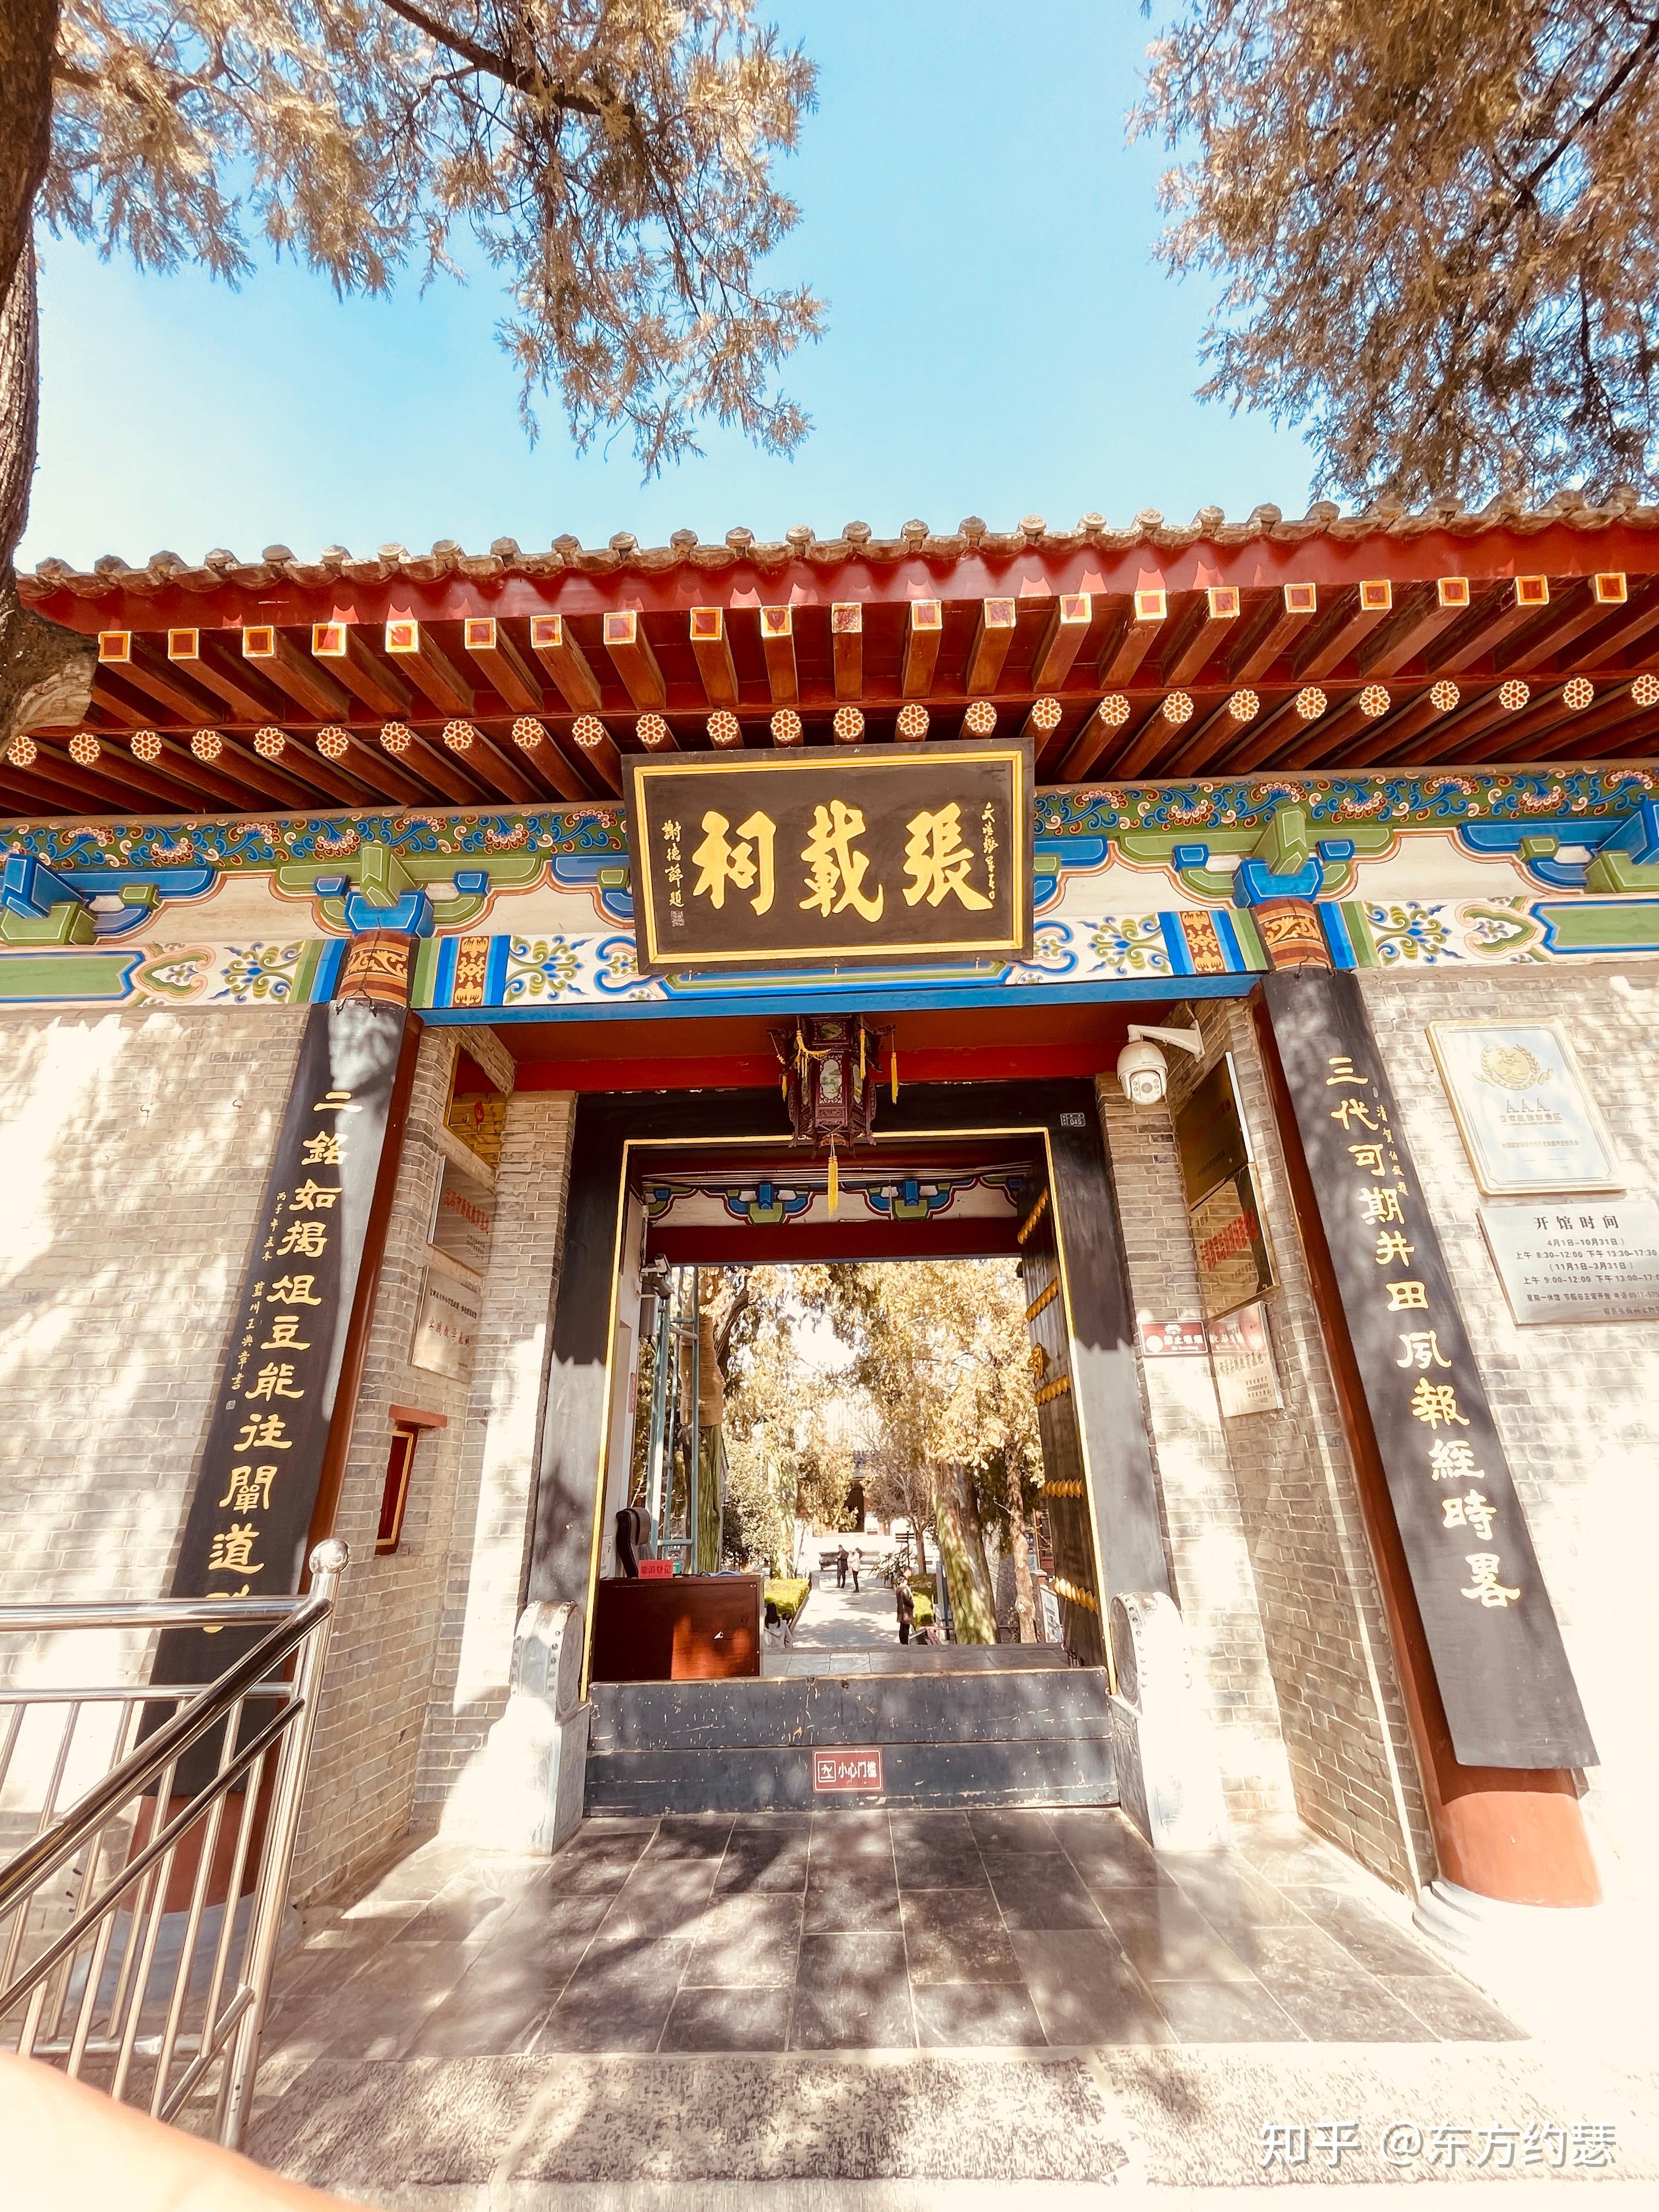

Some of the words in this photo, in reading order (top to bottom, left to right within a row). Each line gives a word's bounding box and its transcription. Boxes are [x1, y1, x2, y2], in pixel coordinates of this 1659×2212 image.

[692, 799, 992, 922] 張載祠
[1533, 1215, 1618, 1230] 开馆时间
[1516, 1251, 1531, 1260] 上午
[1608, 1249, 1657, 1257] 13:30-17:30
[1523, 1276, 1539, 1284] 上午
[1595, 1275, 1612, 1283] 下午
[838, 1761, 877, 1779] 小心门槛
